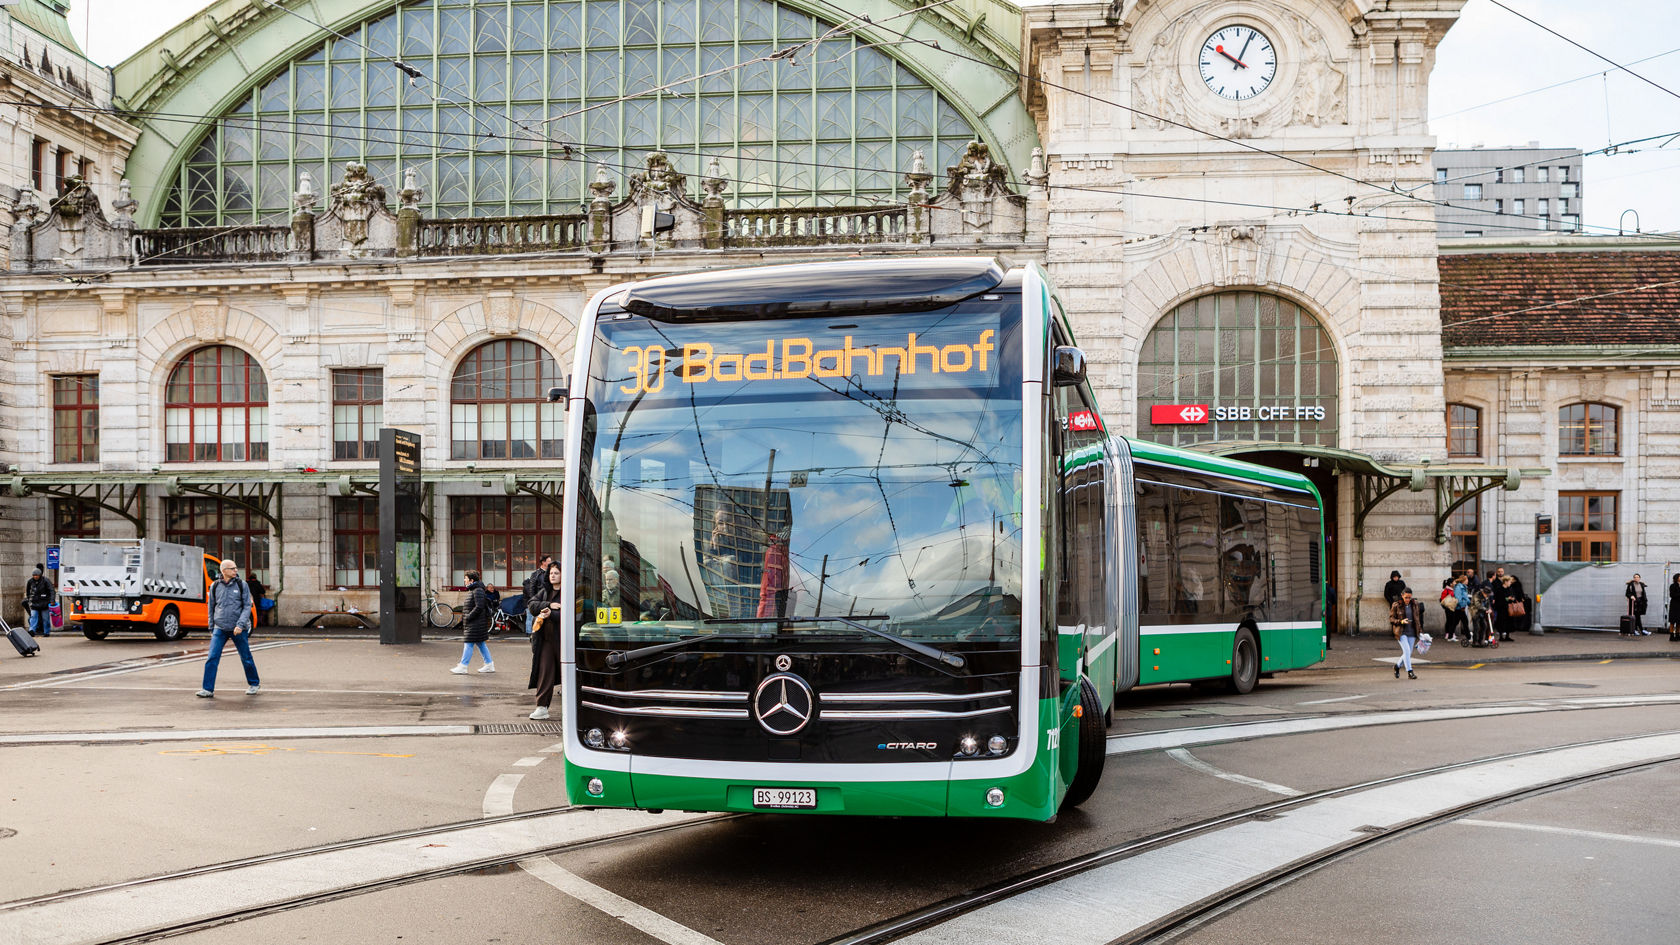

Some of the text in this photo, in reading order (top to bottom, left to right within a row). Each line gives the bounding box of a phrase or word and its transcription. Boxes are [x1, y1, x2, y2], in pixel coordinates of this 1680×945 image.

[620, 345, 665, 394] 30
[1215, 406, 1326, 421] SBB CFF FFS
